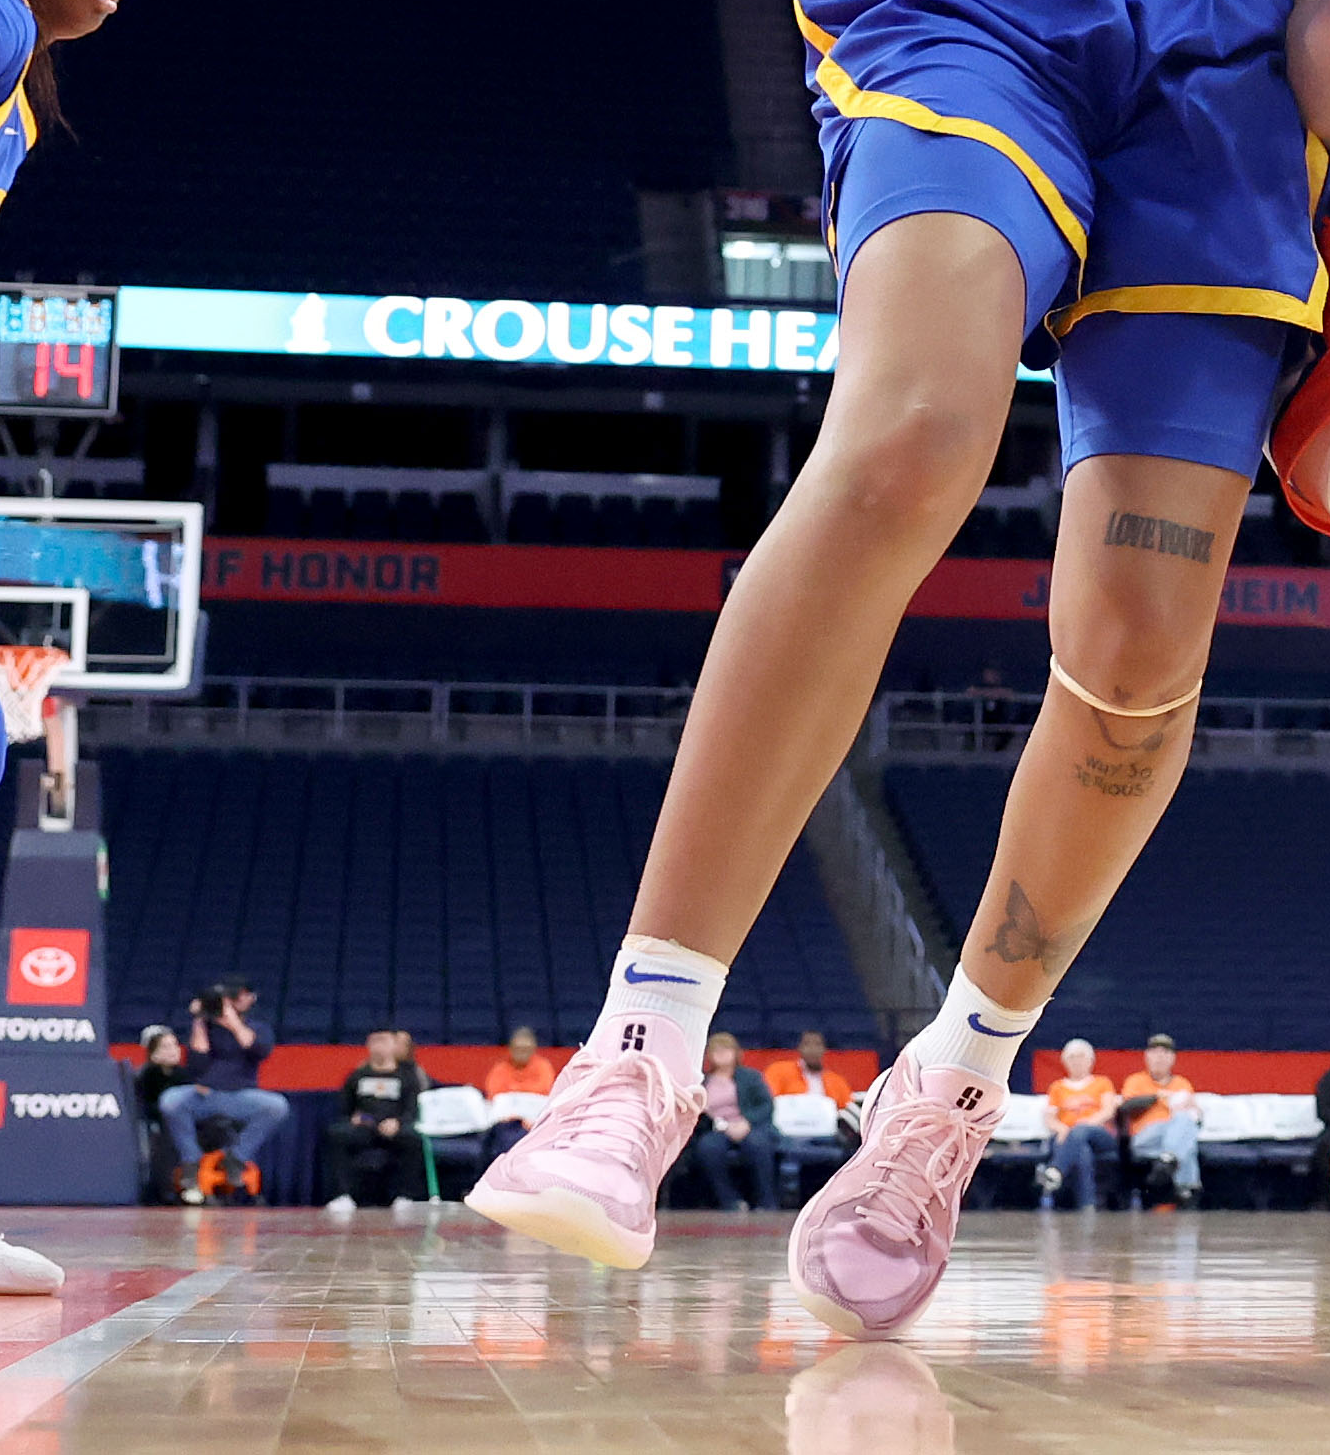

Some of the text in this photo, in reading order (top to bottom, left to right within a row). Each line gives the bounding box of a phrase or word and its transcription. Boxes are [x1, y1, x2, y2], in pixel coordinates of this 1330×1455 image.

[363, 294, 841, 372] CROUSE HE
[32, 341, 96, 401] 14
[261, 550, 441, 593] HONOR
[10, 1094, 121, 1119] TOYOTA
